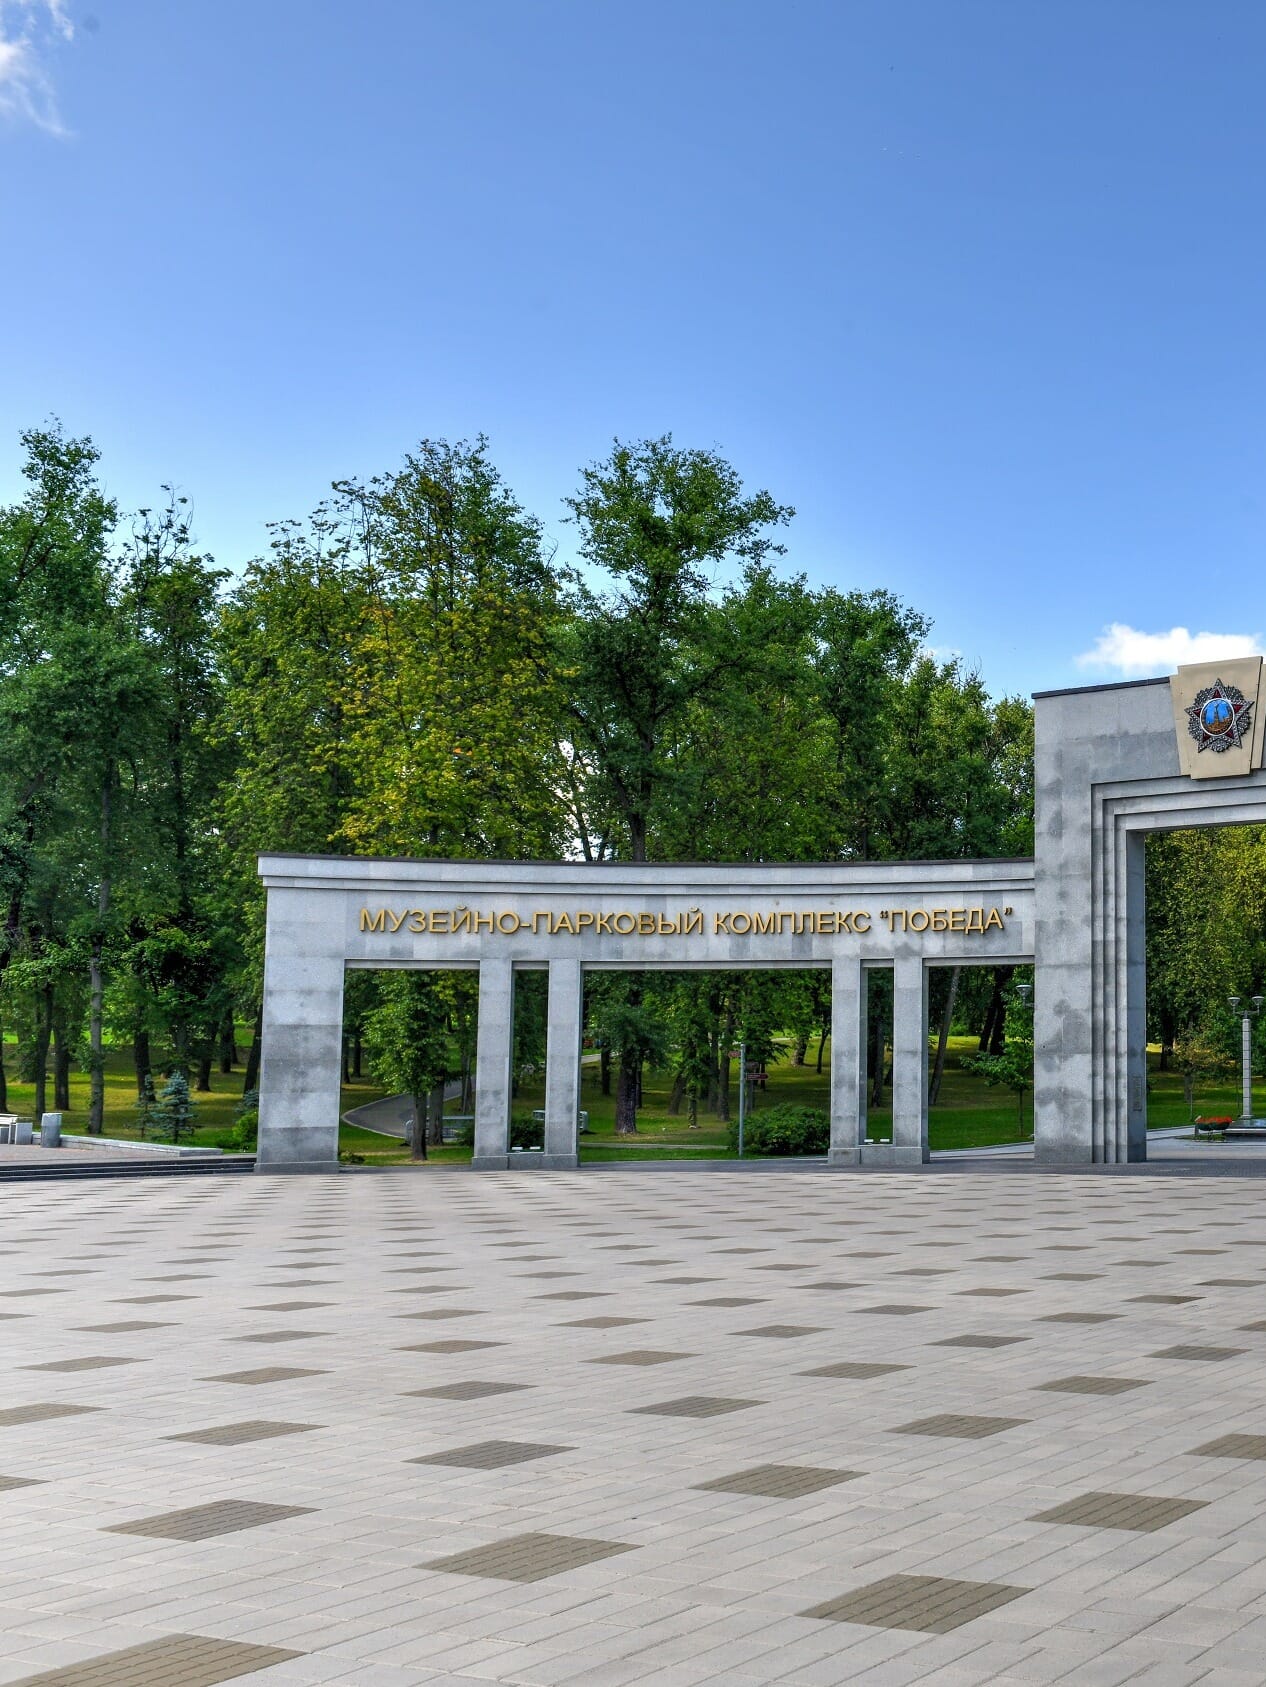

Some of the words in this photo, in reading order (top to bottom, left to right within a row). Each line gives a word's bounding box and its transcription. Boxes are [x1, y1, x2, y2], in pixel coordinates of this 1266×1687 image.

[359, 905, 703, 934] МУЗЕЙНО-ПАРКОВЫЙ
[713, 911, 871, 934] КОМПЛЕКС
[880, 907, 1012, 934] “ПОБЕДА”
